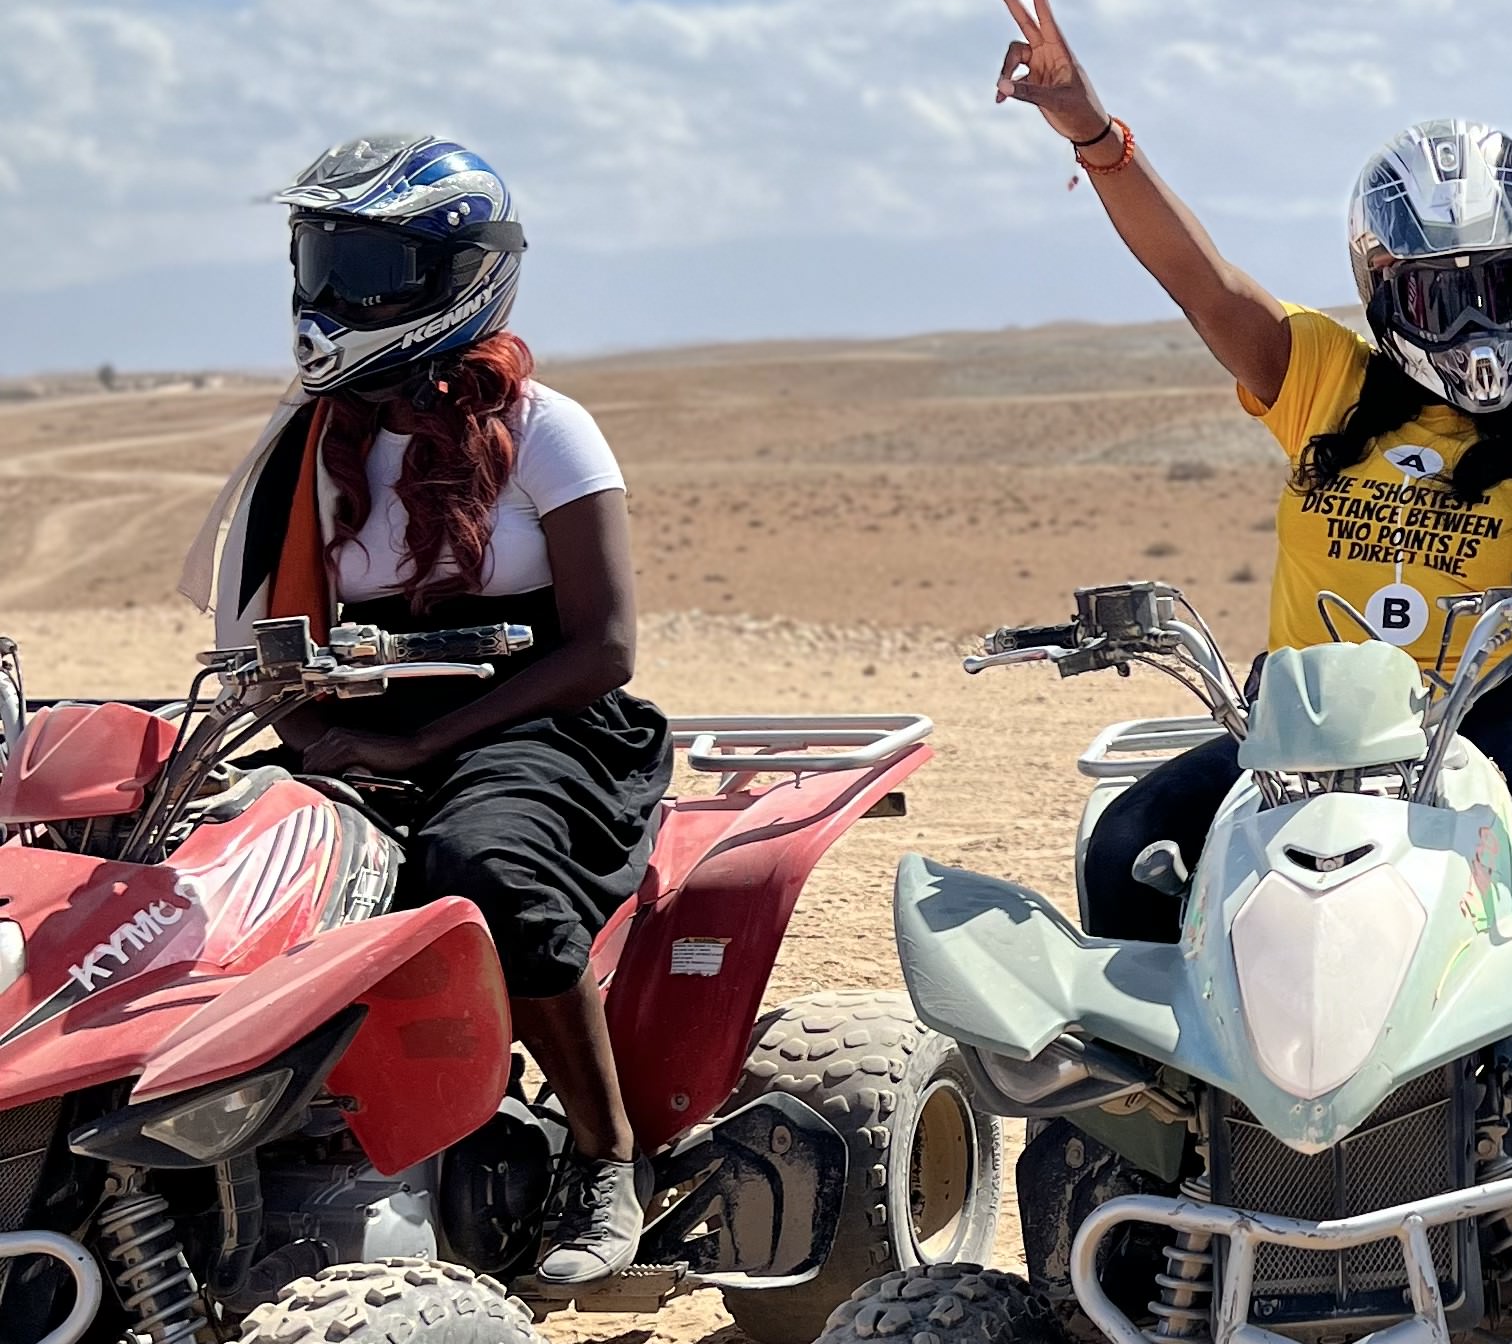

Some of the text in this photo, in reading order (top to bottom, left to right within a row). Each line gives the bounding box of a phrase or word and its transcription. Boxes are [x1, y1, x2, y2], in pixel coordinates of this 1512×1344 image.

[401, 281, 496, 350] KENNY
[1396, 454, 1426, 473] A
[1314, 474, 1358, 494] HE
[1301, 491, 1503, 540] DISTANCE BETWEEN
[1327, 518, 1480, 559] TWO POINTS IS
[1327, 540, 1341, 560] A
[1347, 541, 1418, 565] DIRECT
[1382, 597, 1411, 629] B
[67, 874, 206, 992] KYMCO
